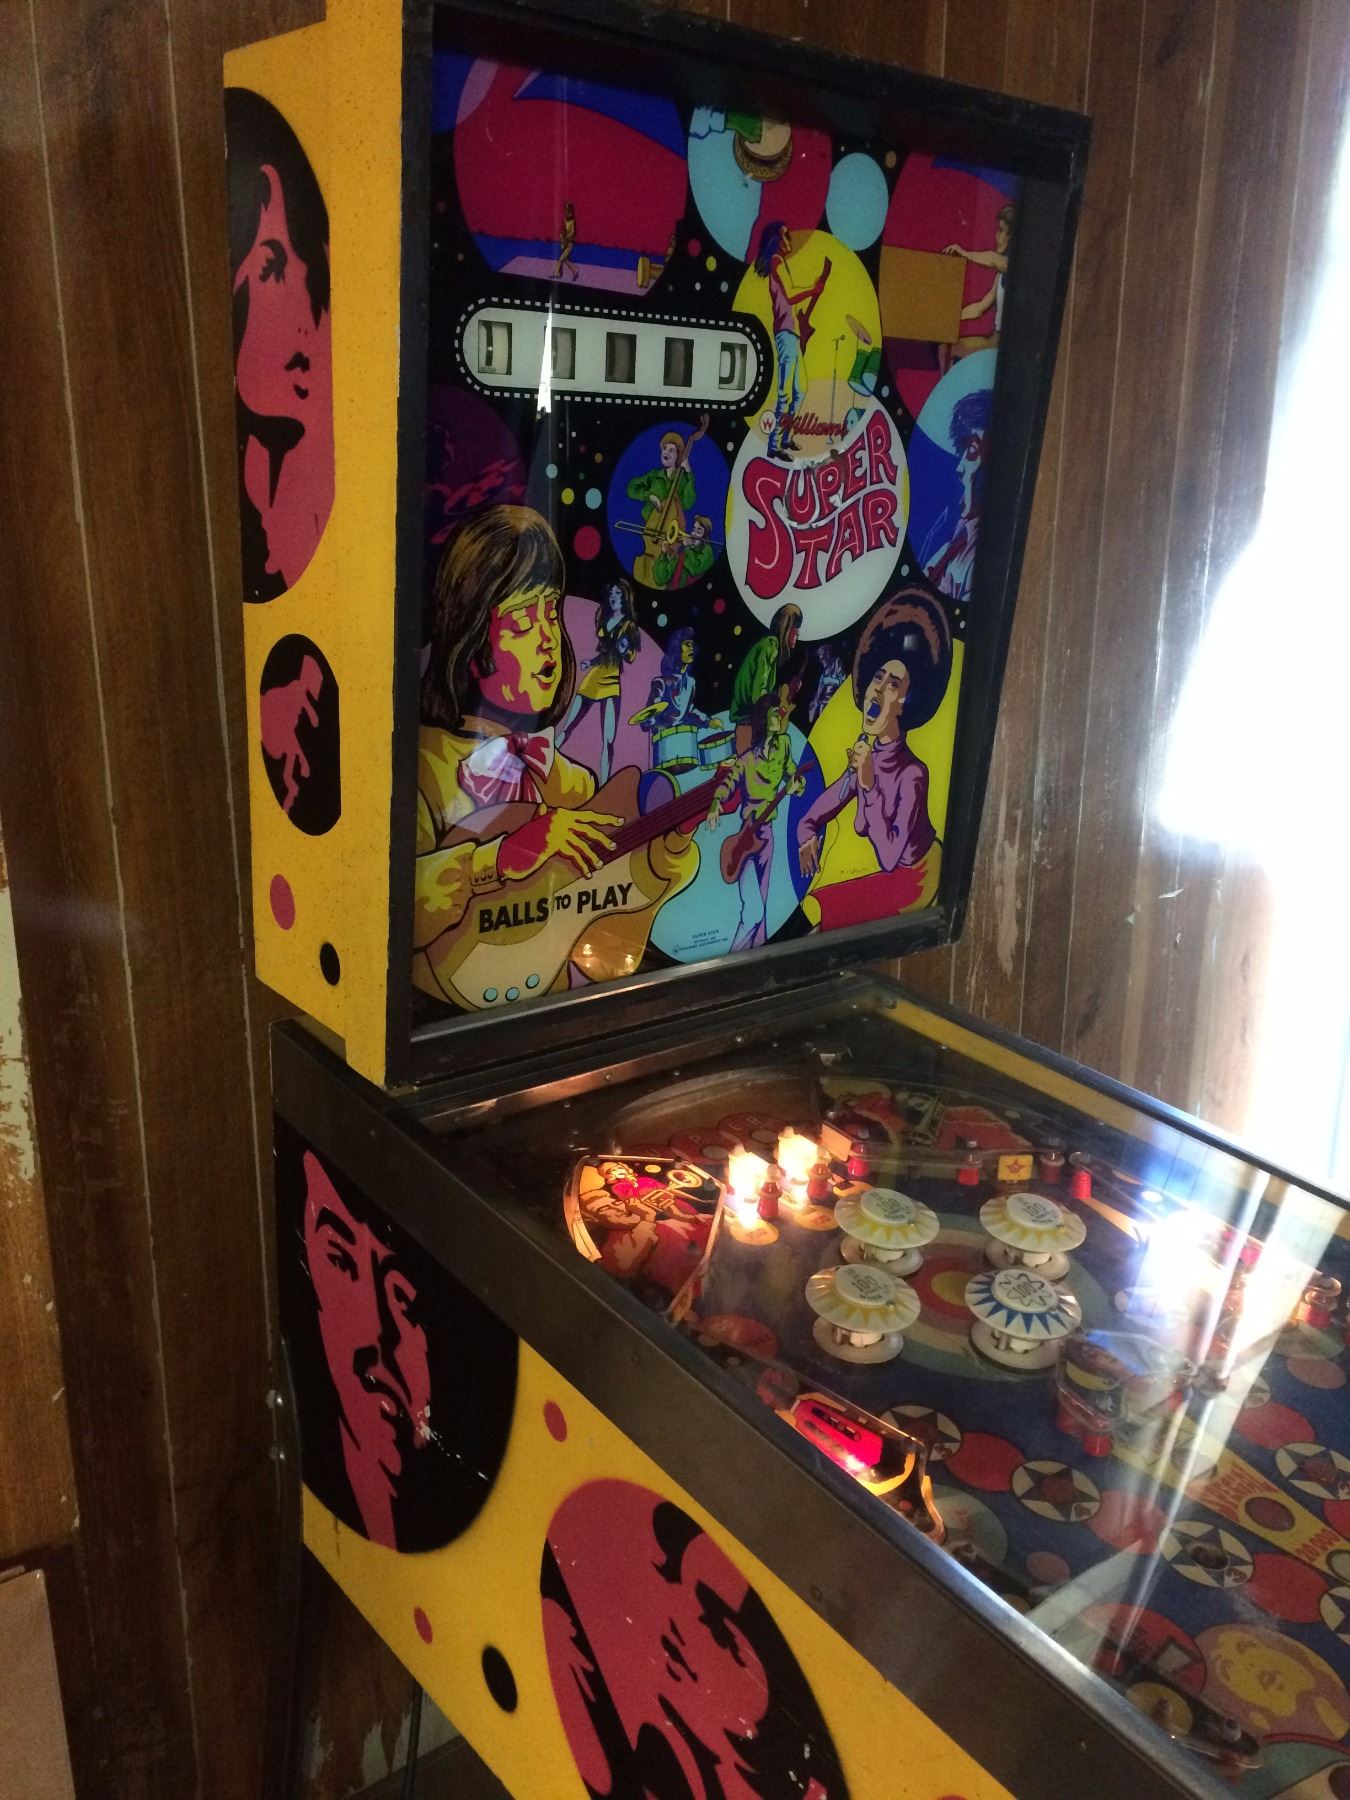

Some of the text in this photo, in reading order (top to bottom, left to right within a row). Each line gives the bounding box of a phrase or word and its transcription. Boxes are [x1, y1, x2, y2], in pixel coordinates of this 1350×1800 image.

[780, 412, 849, 441] Williams
[742, 410, 898, 599] SUPER
[479, 882, 633, 933] BALLS TO PLAY
[876, 1198, 900, 1212] 100
[1022, 1203, 1046, 1217] 100
[851, 1275, 878, 1291] 100
[1012, 1281, 1038, 1298] 100
